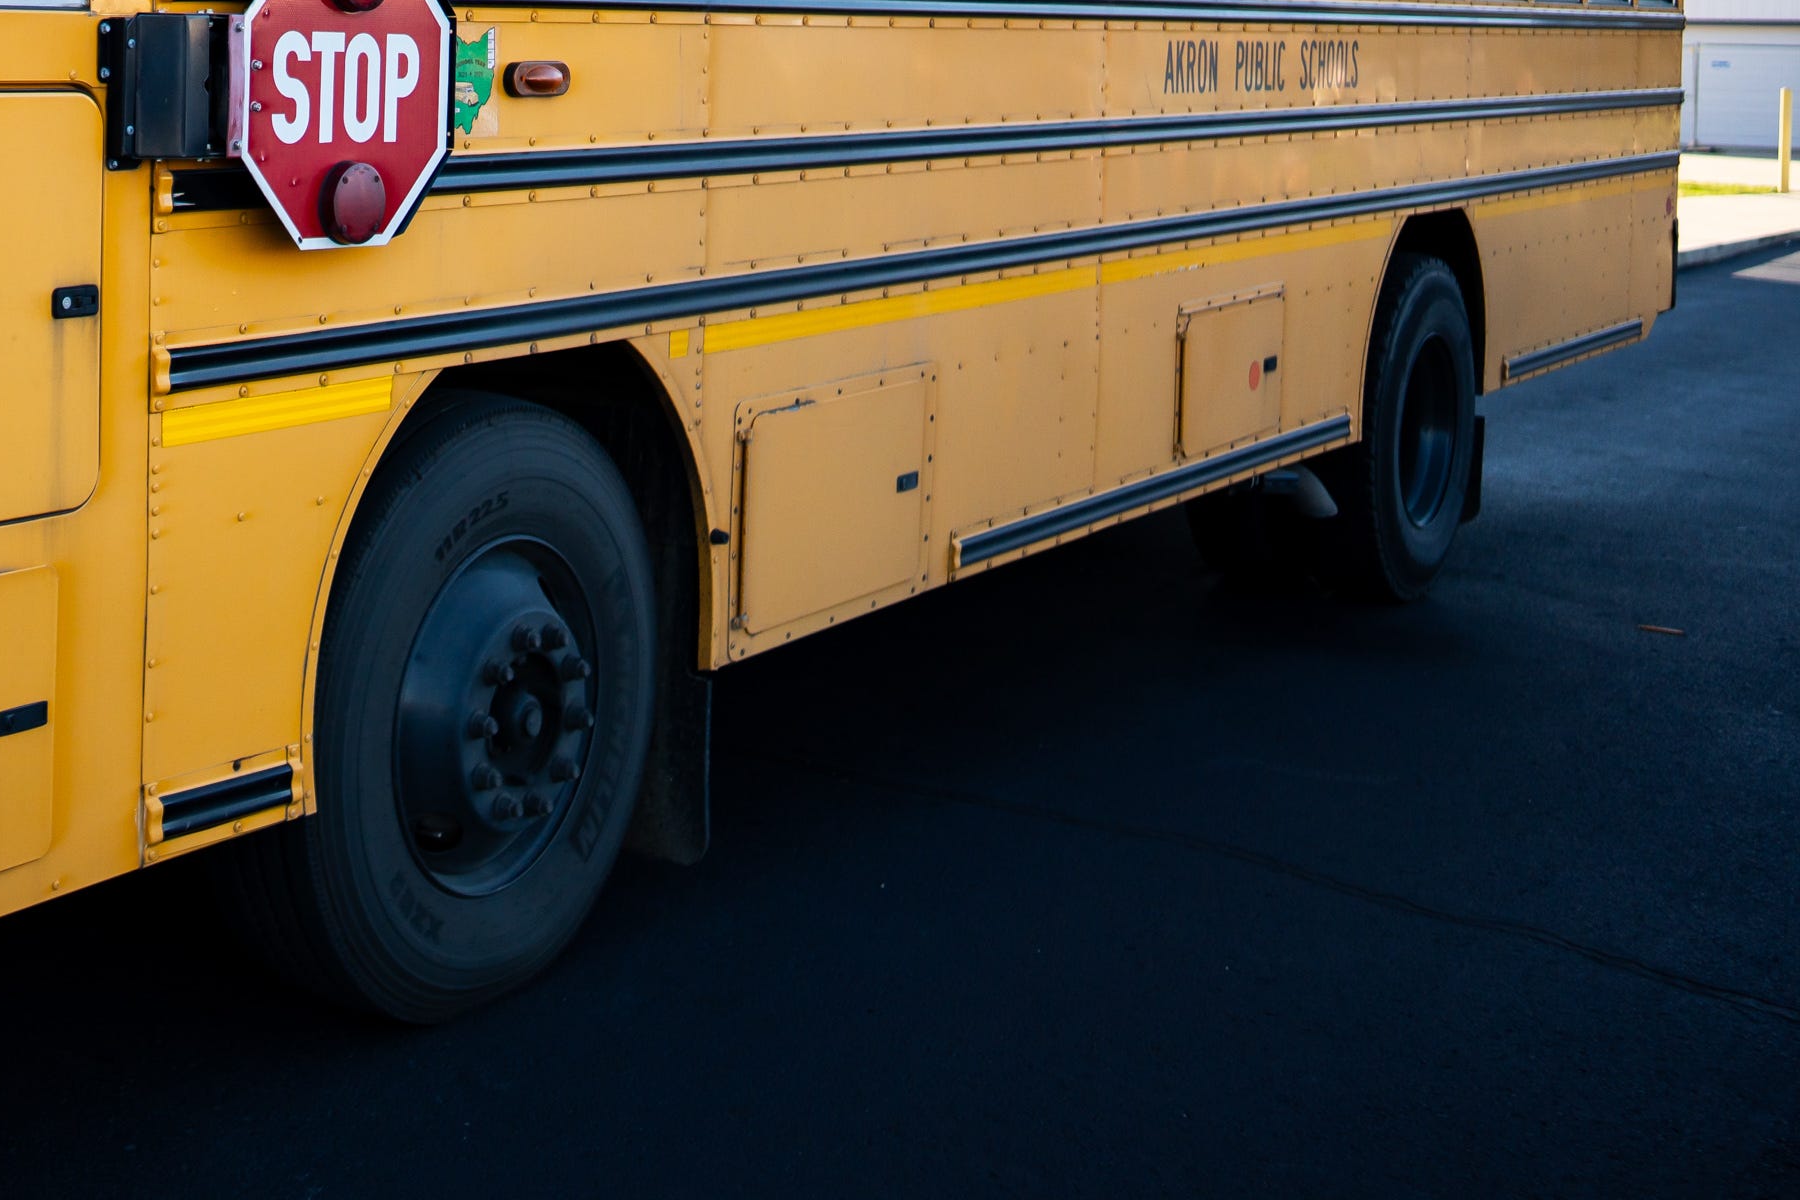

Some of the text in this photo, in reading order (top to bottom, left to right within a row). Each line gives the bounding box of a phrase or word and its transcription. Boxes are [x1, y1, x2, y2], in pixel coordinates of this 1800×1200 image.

[271, 30, 420, 145] STOP
[1164, 39, 1359, 94] AKRON PUBLIC SCHOOLS
